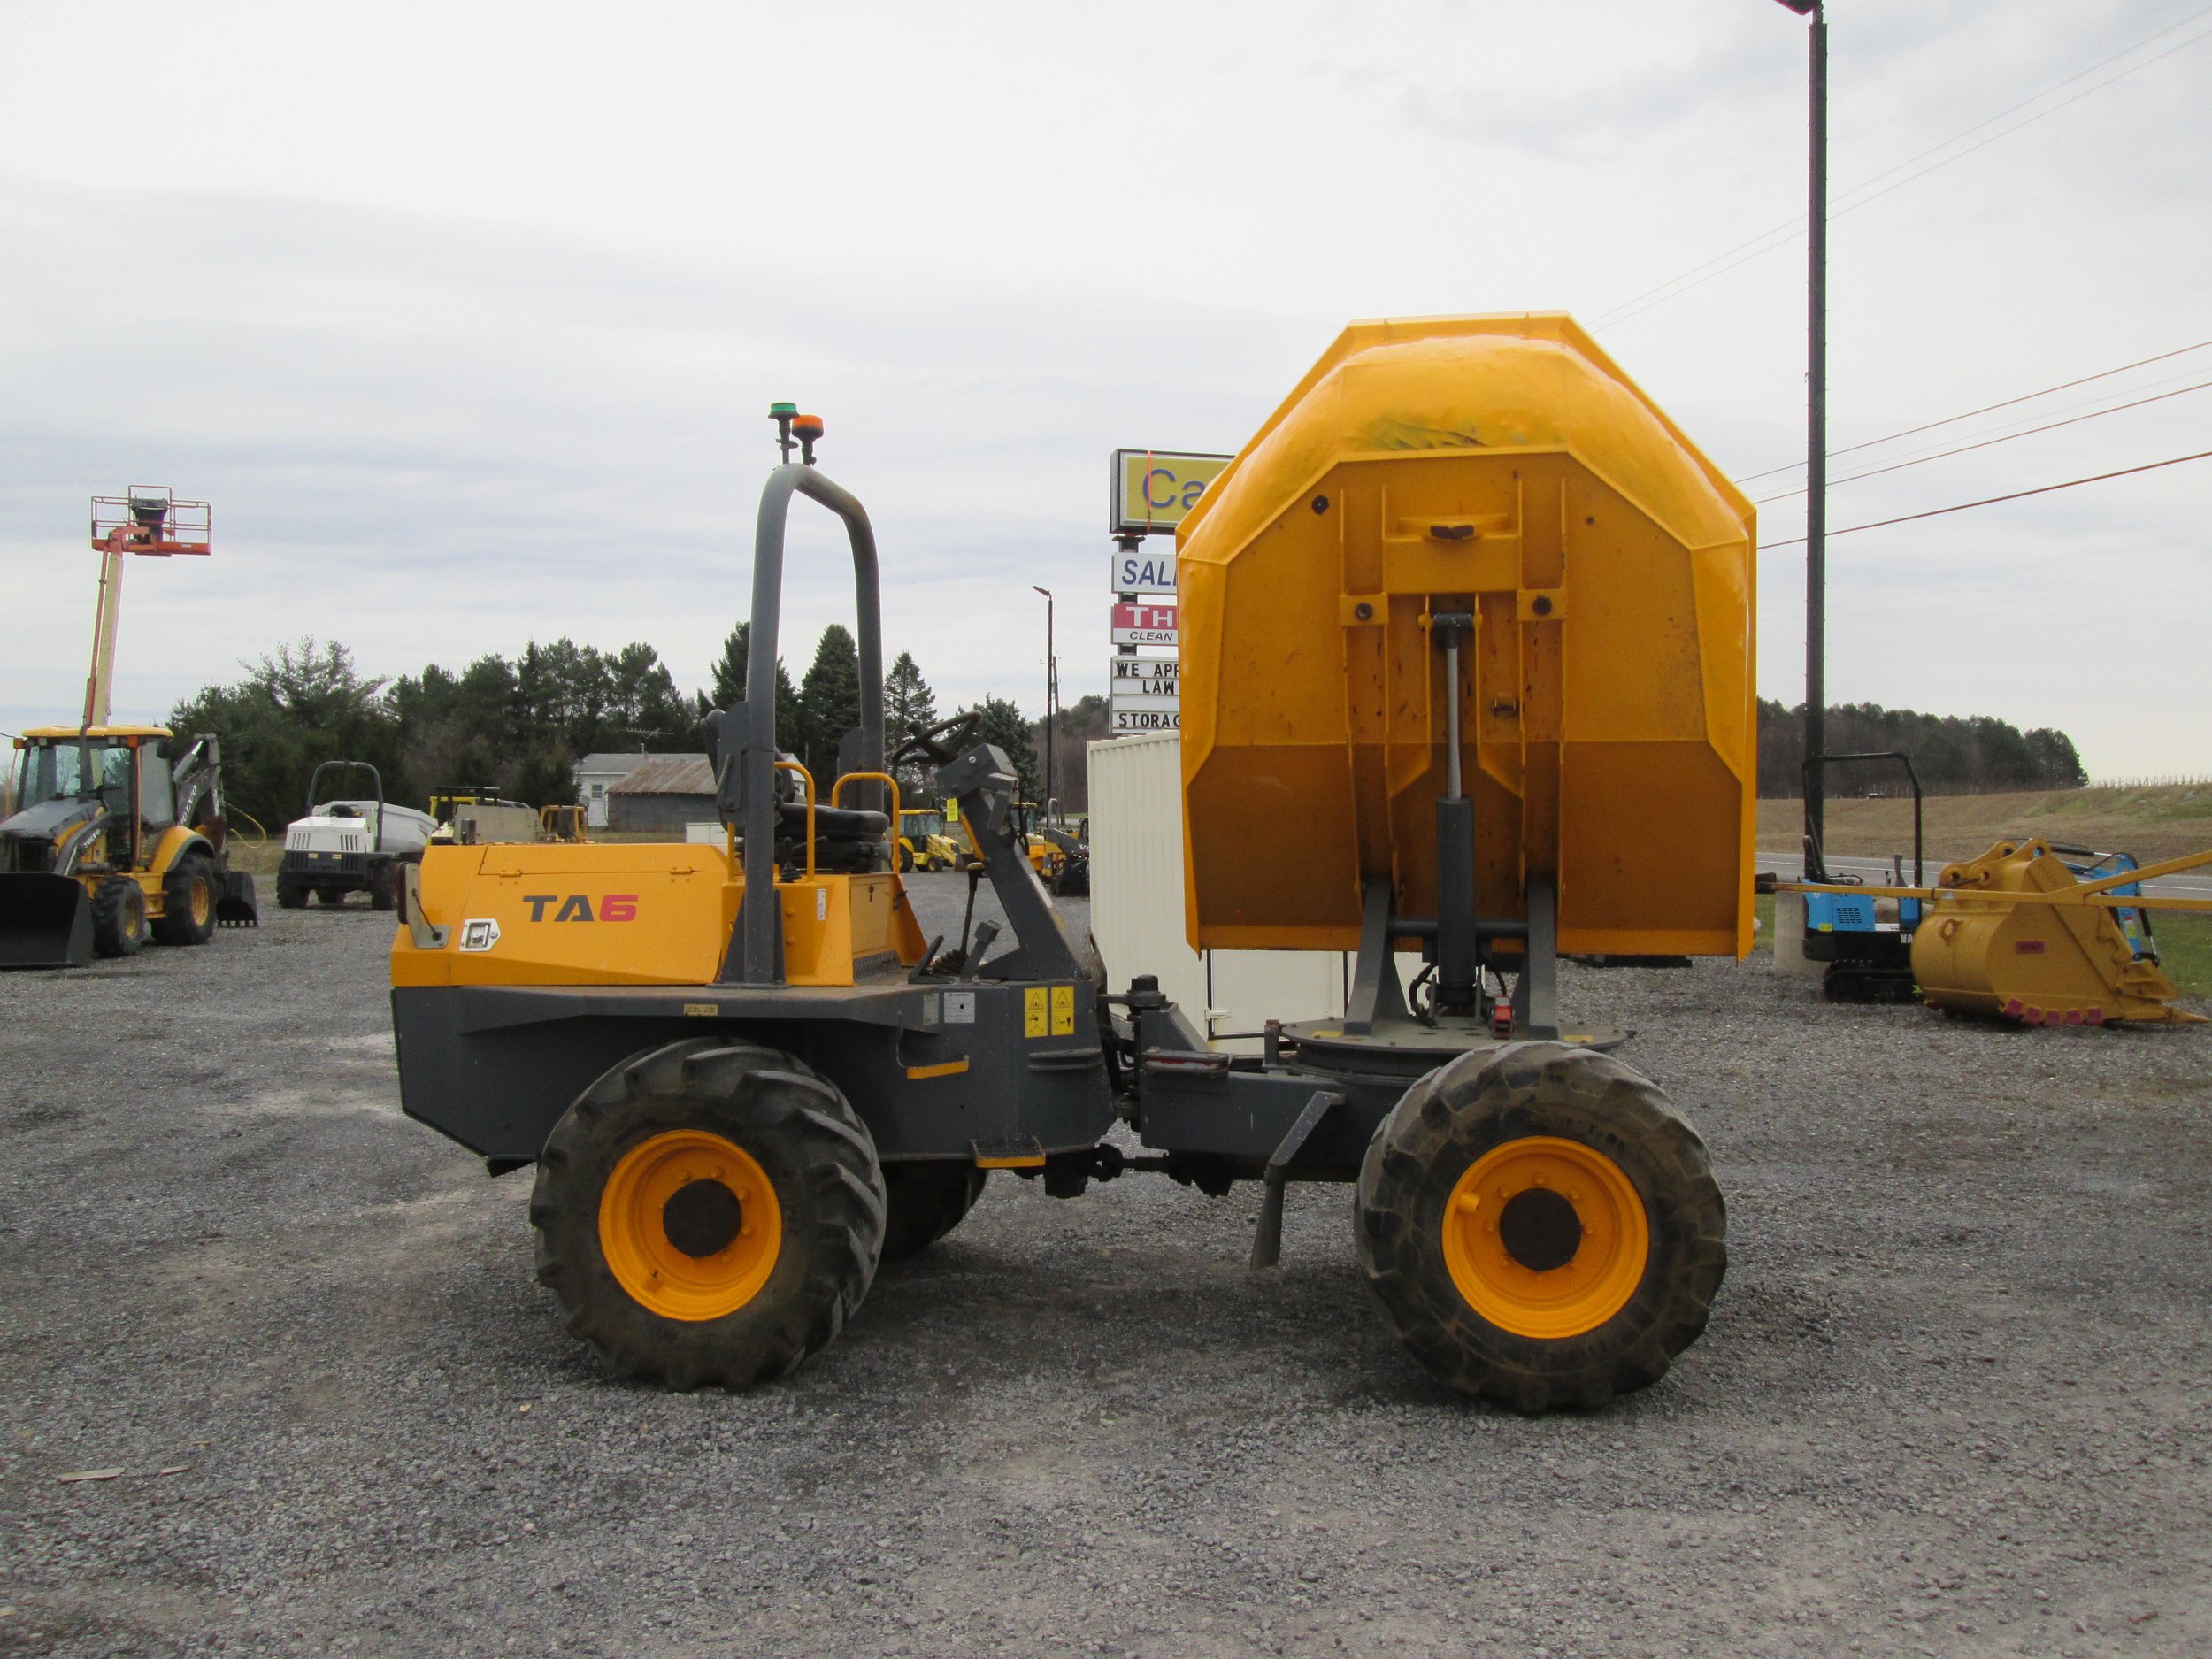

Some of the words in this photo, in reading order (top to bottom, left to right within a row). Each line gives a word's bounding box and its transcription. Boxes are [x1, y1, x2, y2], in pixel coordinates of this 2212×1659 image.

[1142, 467, 1206, 510] Ca
[1121, 559, 1177, 586] SAL
[1125, 606, 1173, 627] TH
[1129, 631, 1173, 641] CLEAN
[1116, 663, 1140, 677] WE
[1142, 680, 1174, 695] LAW
[1118, 713, 1180, 728] STORAG
[522, 894, 639, 922] TA6
